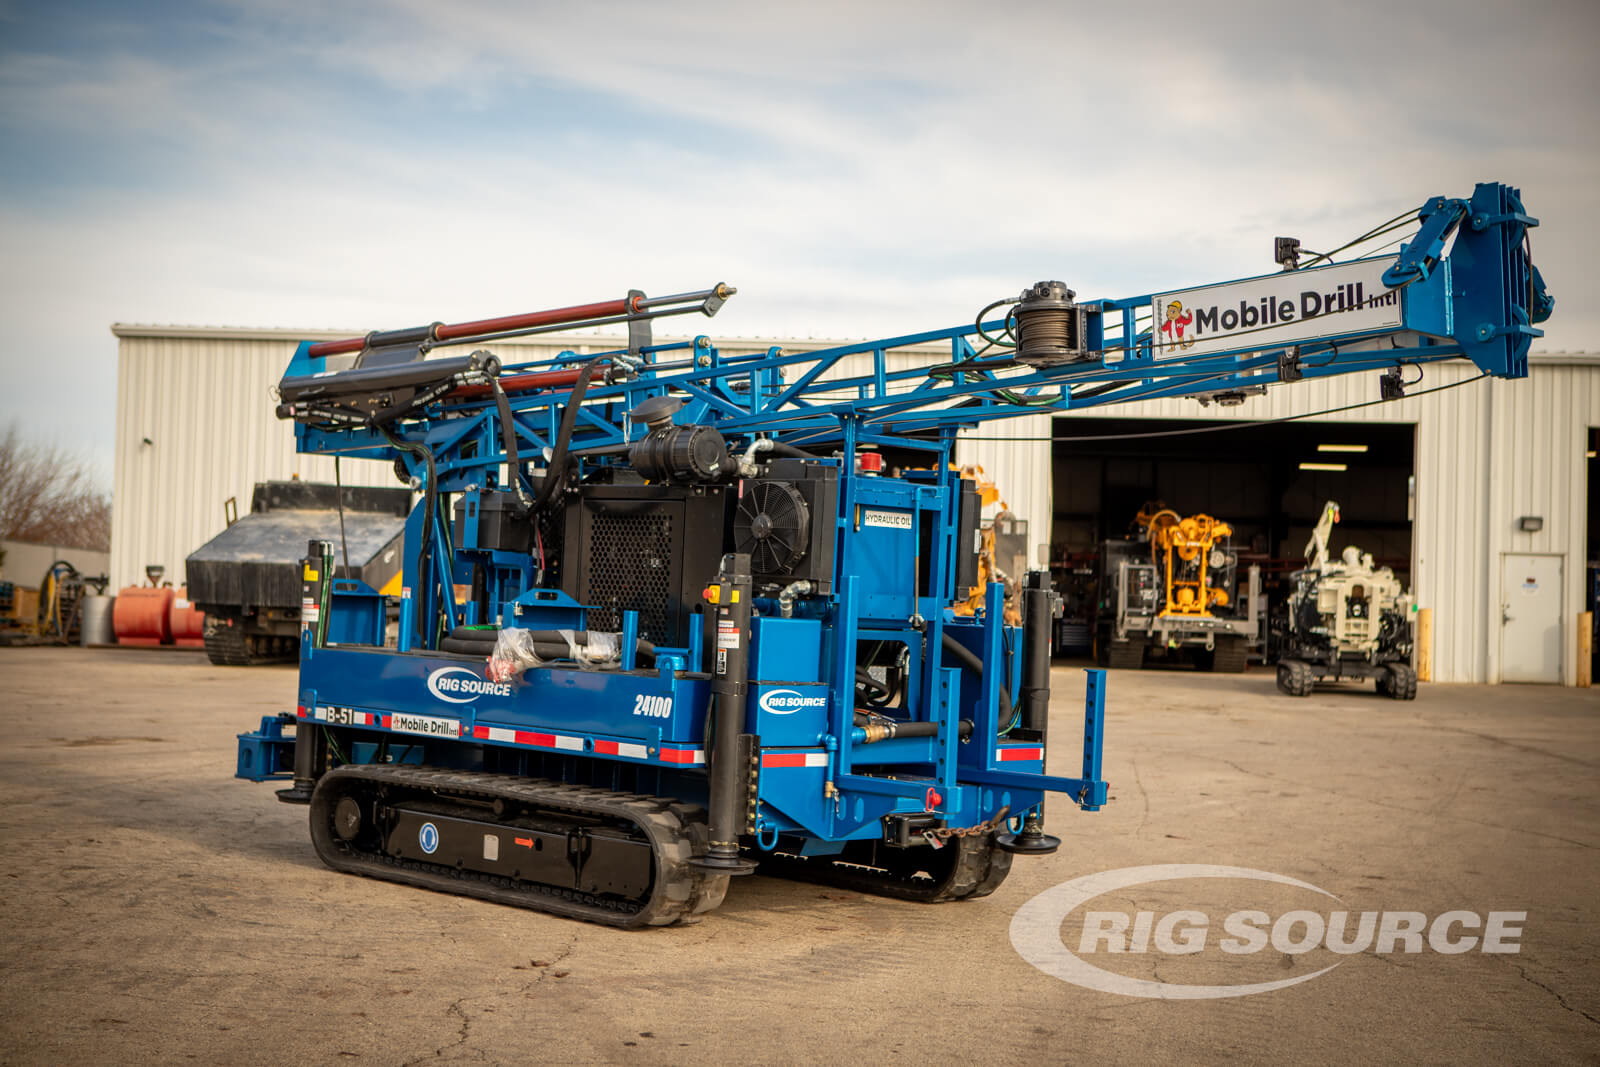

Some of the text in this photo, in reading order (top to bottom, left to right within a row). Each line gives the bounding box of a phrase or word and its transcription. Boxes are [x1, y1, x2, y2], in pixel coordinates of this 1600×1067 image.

[1195, 296, 1295, 335] Mobile
[1301, 282, 1363, 319] Drill
[866, 514, 911, 526] HYDRAULIC OIL
[438, 677, 511, 696] RIG SOURCE
[634, 694, 672, 718] 24100
[768, 697, 826, 707] RIG SOURCE
[327, 706, 353, 724] B-51
[400, 717, 429, 732] Mobile
[431, 720, 450, 735] Drill
